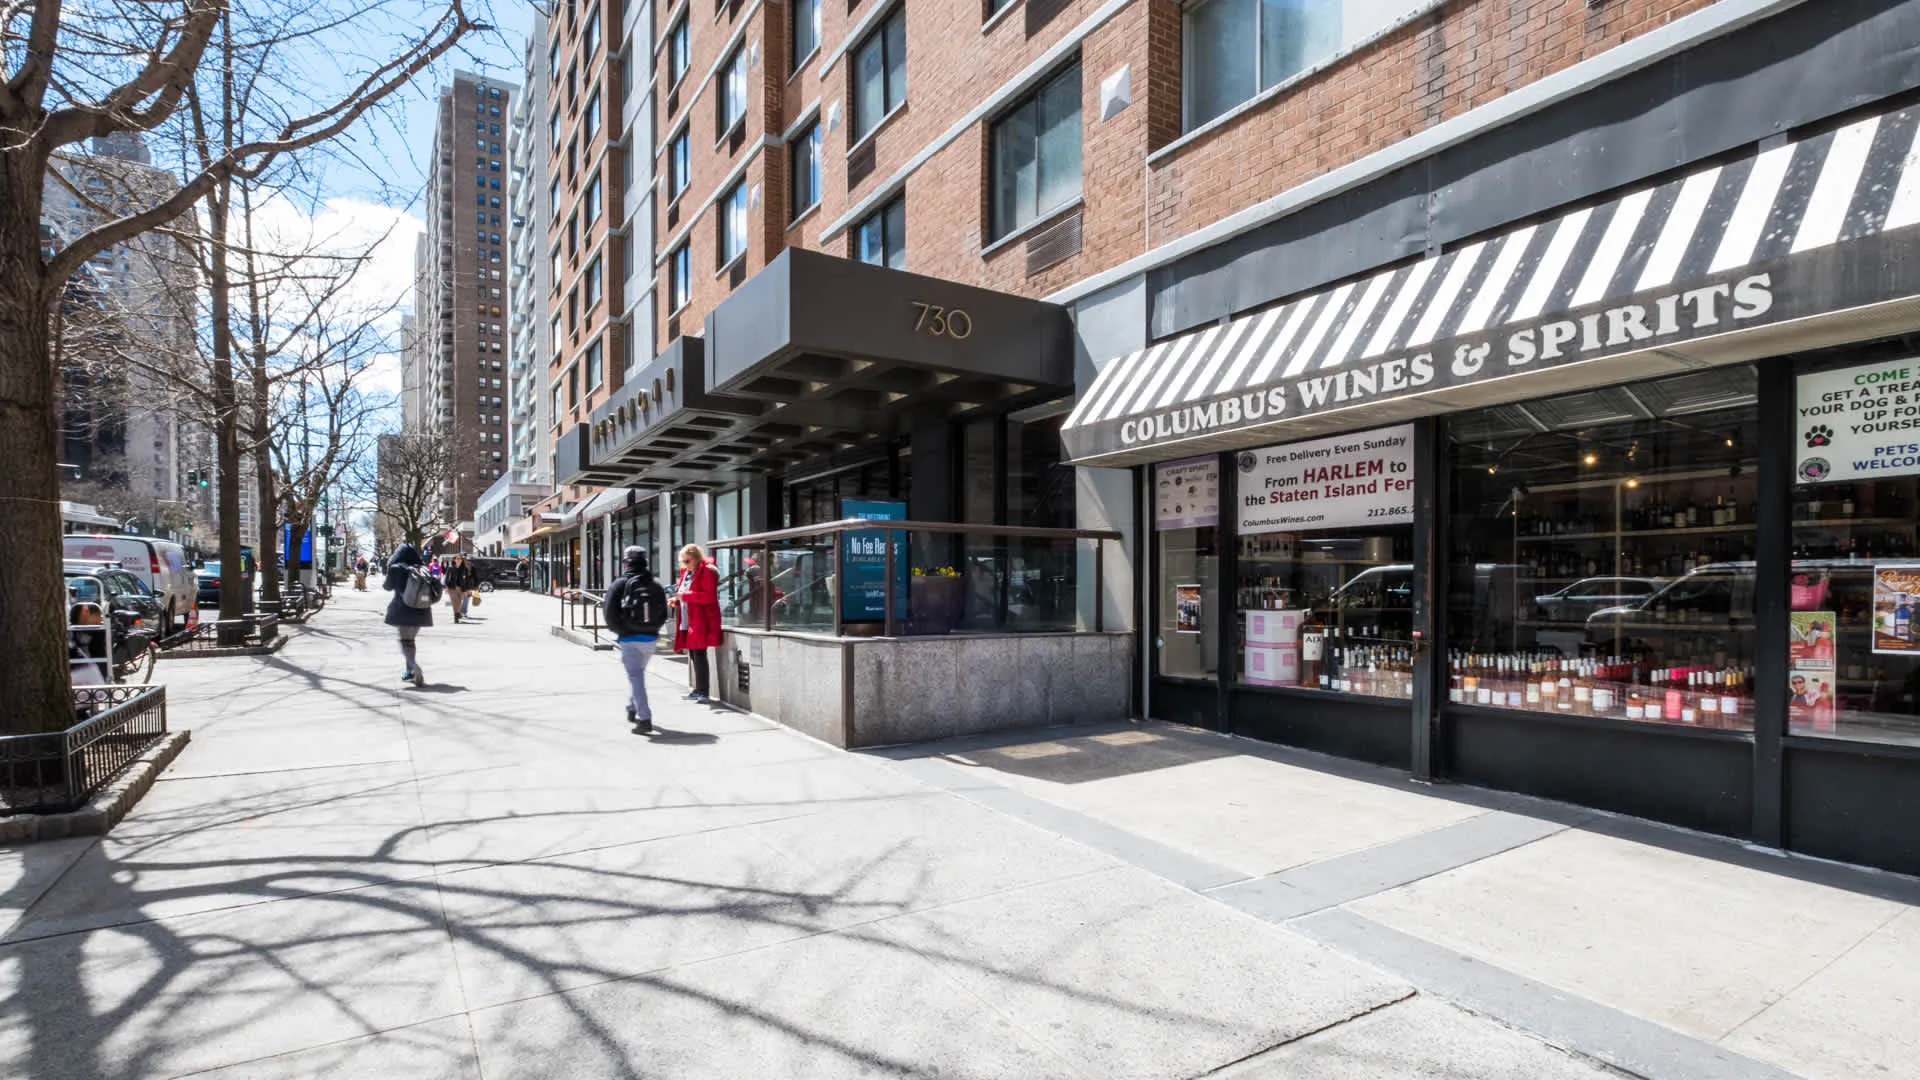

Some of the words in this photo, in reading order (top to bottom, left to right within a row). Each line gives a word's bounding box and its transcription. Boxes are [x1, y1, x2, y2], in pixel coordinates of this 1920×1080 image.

[911, 301, 972, 339] 730
[1121, 386, 1287, 445] COLUMBUS
[1296, 352, 1435, 408] WINES
[1451, 341, 1491, 377] &
[1507, 272, 1774, 366] SPIRITS
[1854, 368, 1910, 385] COME
[1822, 389, 1854, 402] GET
[1859, 387, 1871, 397] A
[1799, 403, 1844, 417] YOUR
[1850, 397, 1888, 411] DOG
[1895, 395, 1908, 405] &
[1864, 410, 1887, 421] UP
[1894, 406, 1920, 418] FO
[1266, 455, 1287, 464] Free
[1290, 448, 1331, 461] Delivery
[1334, 444, 1360, 455] Even
[1363, 436, 1407, 450] Sunday
[1874, 443, 1918, 457] PETS
[1265, 476, 1298, 488] From
[1303, 459, 1384, 484] HARLEM
[1390, 460, 1407, 473] to
[1245, 494, 1266, 507] the
[1269, 488, 1319, 504] Staten
[1324, 480, 1377, 498] Island
[1242, 513, 1325, 528] ColumbusWines.com
[851, 537, 861, 554] No
[862, 537, 873, 554] Fee
